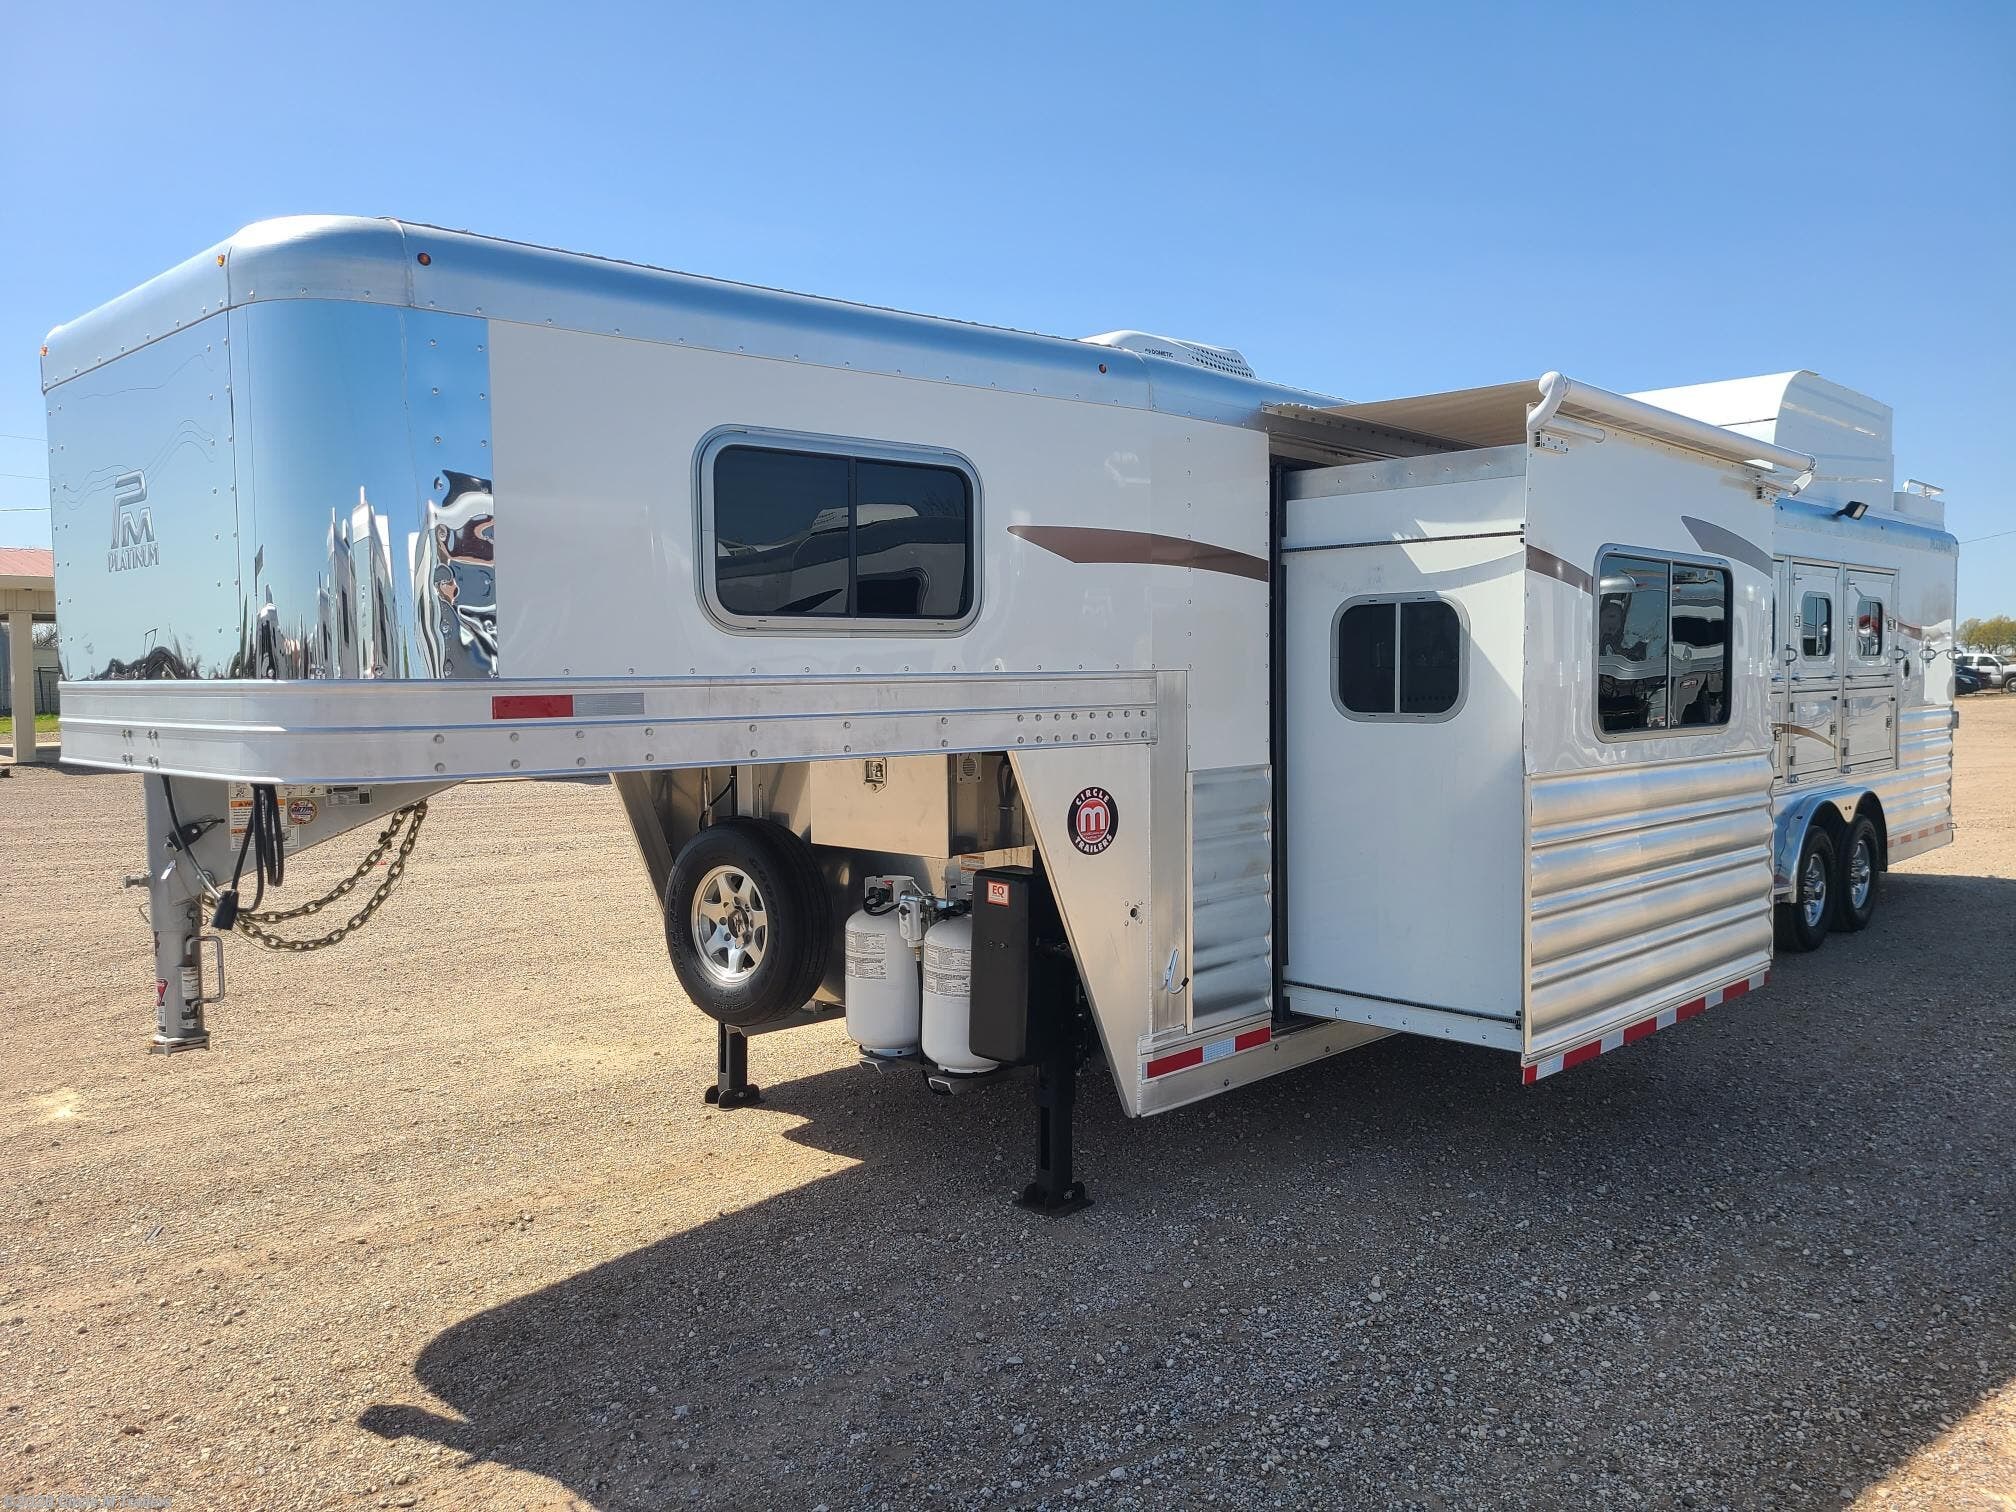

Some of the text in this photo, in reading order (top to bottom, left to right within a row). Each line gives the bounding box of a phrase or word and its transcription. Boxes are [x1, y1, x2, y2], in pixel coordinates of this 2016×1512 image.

[1152, 349, 1174, 359] DOMETIC
[107, 542, 160, 573] PLATINUM
[1075, 788, 1110, 806] CIRCLE
[1075, 833, 1113, 853] TRAILERS
[992, 884, 1005, 898] EQ
